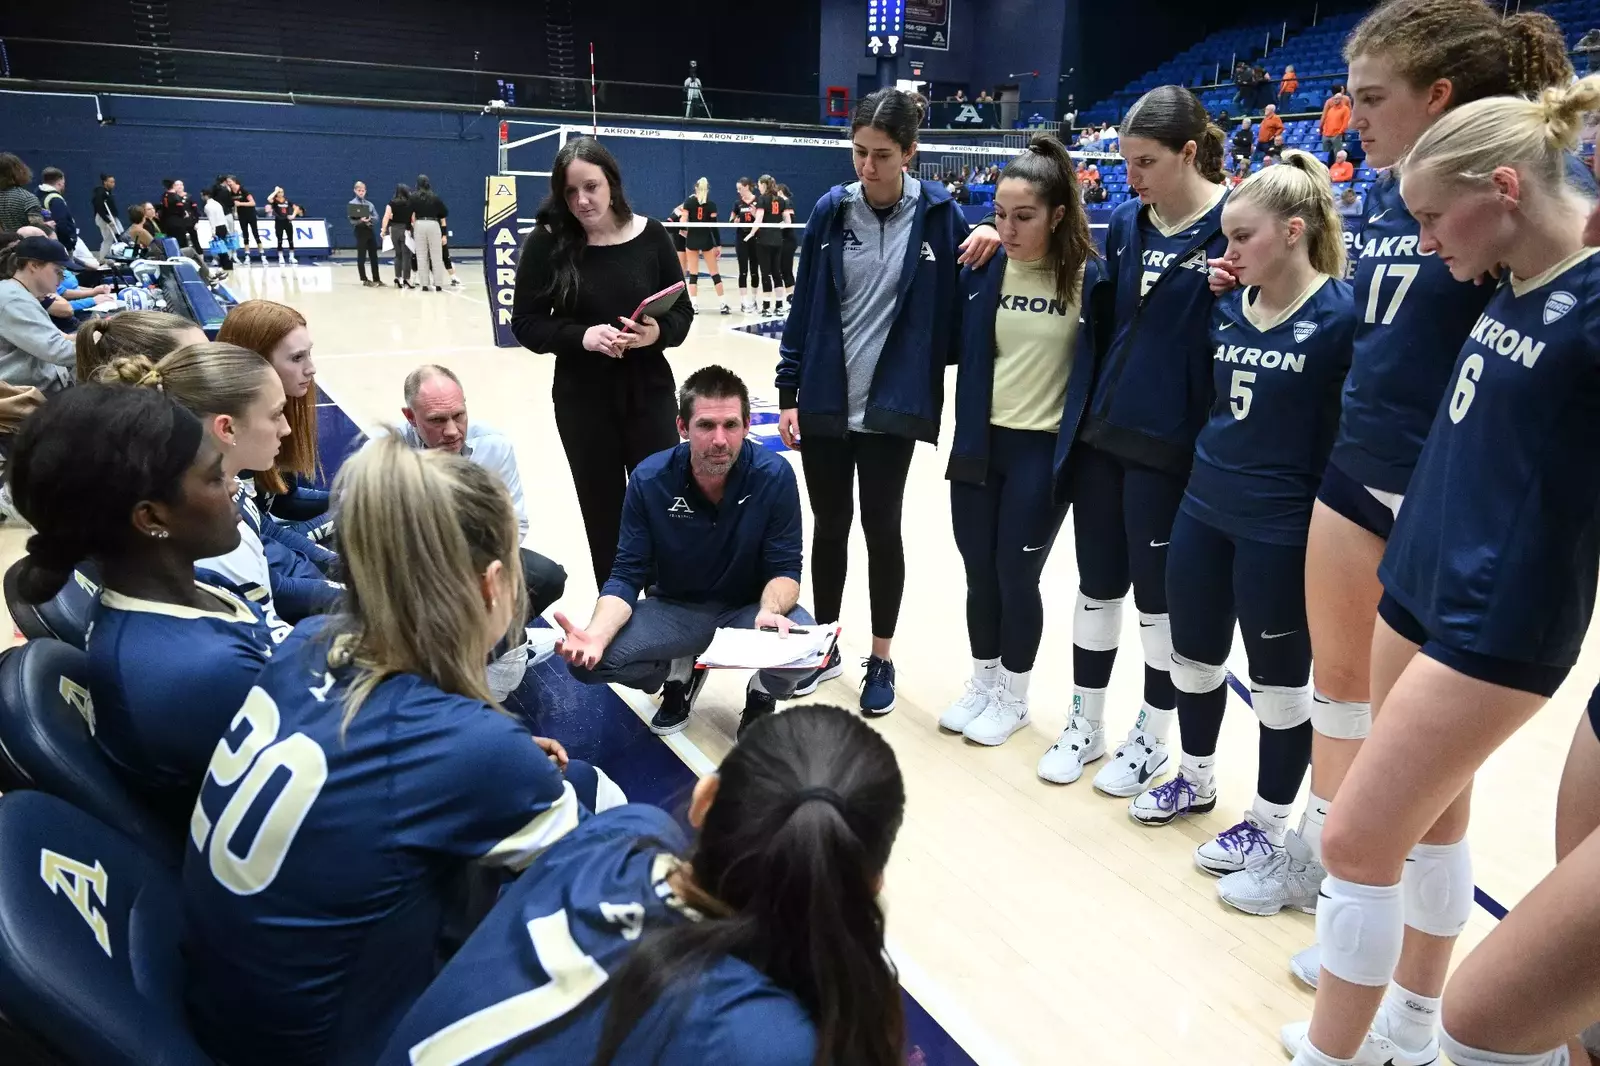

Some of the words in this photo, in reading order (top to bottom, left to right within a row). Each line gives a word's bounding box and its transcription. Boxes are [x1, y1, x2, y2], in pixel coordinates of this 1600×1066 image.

[954, 104, 983, 123] A
[603, 127, 636, 135] AKRON
[640, 129, 661, 137] ZIPS
[702, 132, 732, 140] AKRON
[735, 134, 755, 142] ZIPS
[495, 184, 513, 196] A
[842, 229, 863, 246] A
[1359, 235, 1436, 259] AKR
[920, 241, 936, 262] A
[1180, 249, 1209, 274] A
[494, 228, 517, 325] AKRON
[998, 294, 1067, 316] KRON
[1364, 264, 1420, 325] 17
[1213, 344, 1306, 373] AKRON
[1229, 369, 1257, 421] 5
[1449, 353, 1484, 425] 6
[667, 496, 695, 513] A
[190, 685, 329, 896] 20
[40, 847, 112, 958] A
